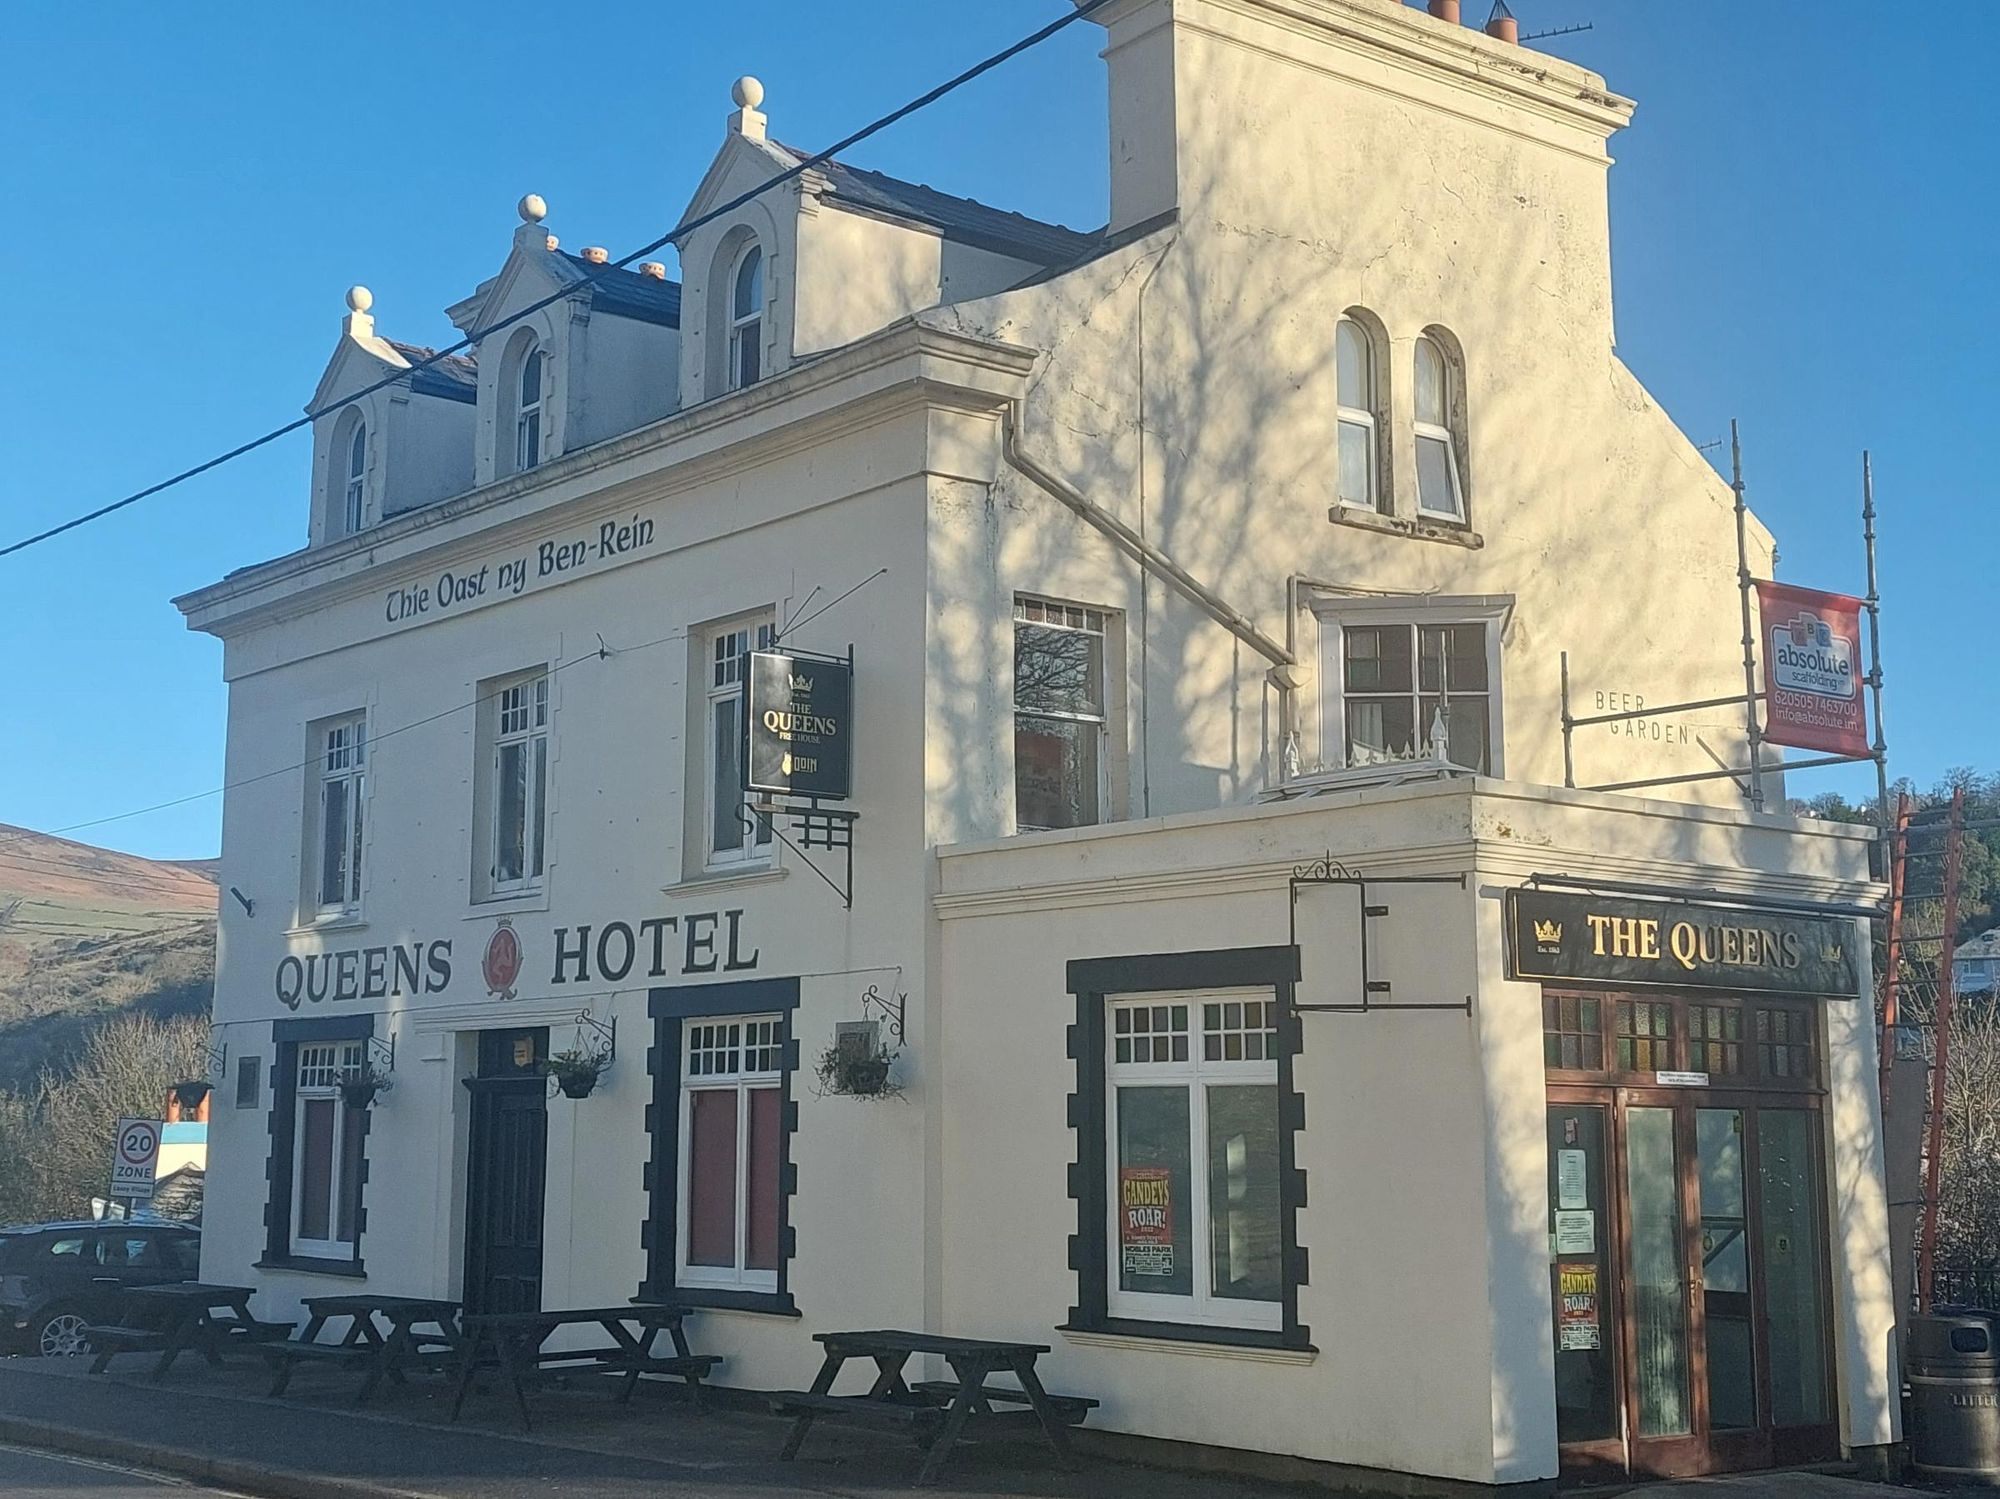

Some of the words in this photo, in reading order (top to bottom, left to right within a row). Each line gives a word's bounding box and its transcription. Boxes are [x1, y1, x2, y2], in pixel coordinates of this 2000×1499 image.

[386, 583, 429, 622] Thie
[437, 564, 489, 607] Oast
[498, 558, 527, 594] ny
[537, 513, 655, 578] Ben-Rein
[1778, 644, 1849, 675] absolute
[1792, 670, 1838, 690] scaffolding
[790, 703, 812, 715] THE
[1595, 691, 1644, 711] BEER
[1774, 691, 1813, 709] 620505
[1821, 697, 1857, 716] 463700
[763, 710, 836, 735] QUEENS
[1775, 707, 1858, 731] info@absolute.im
[1610, 719, 1688, 744] GARDEN
[1587, 914, 1660, 959] THE
[1671, 922, 1801, 971] QUEENS
[276, 939, 452, 1011] QUEENS
[551, 909, 759, 984] HOTEL
[126, 1135, 152, 1152] 20
[117, 1167, 152, 1178] ZONE
[1128, 1207, 1166, 1229] ROAR!
[1564, 1296, 1594, 1313] ROAR!
